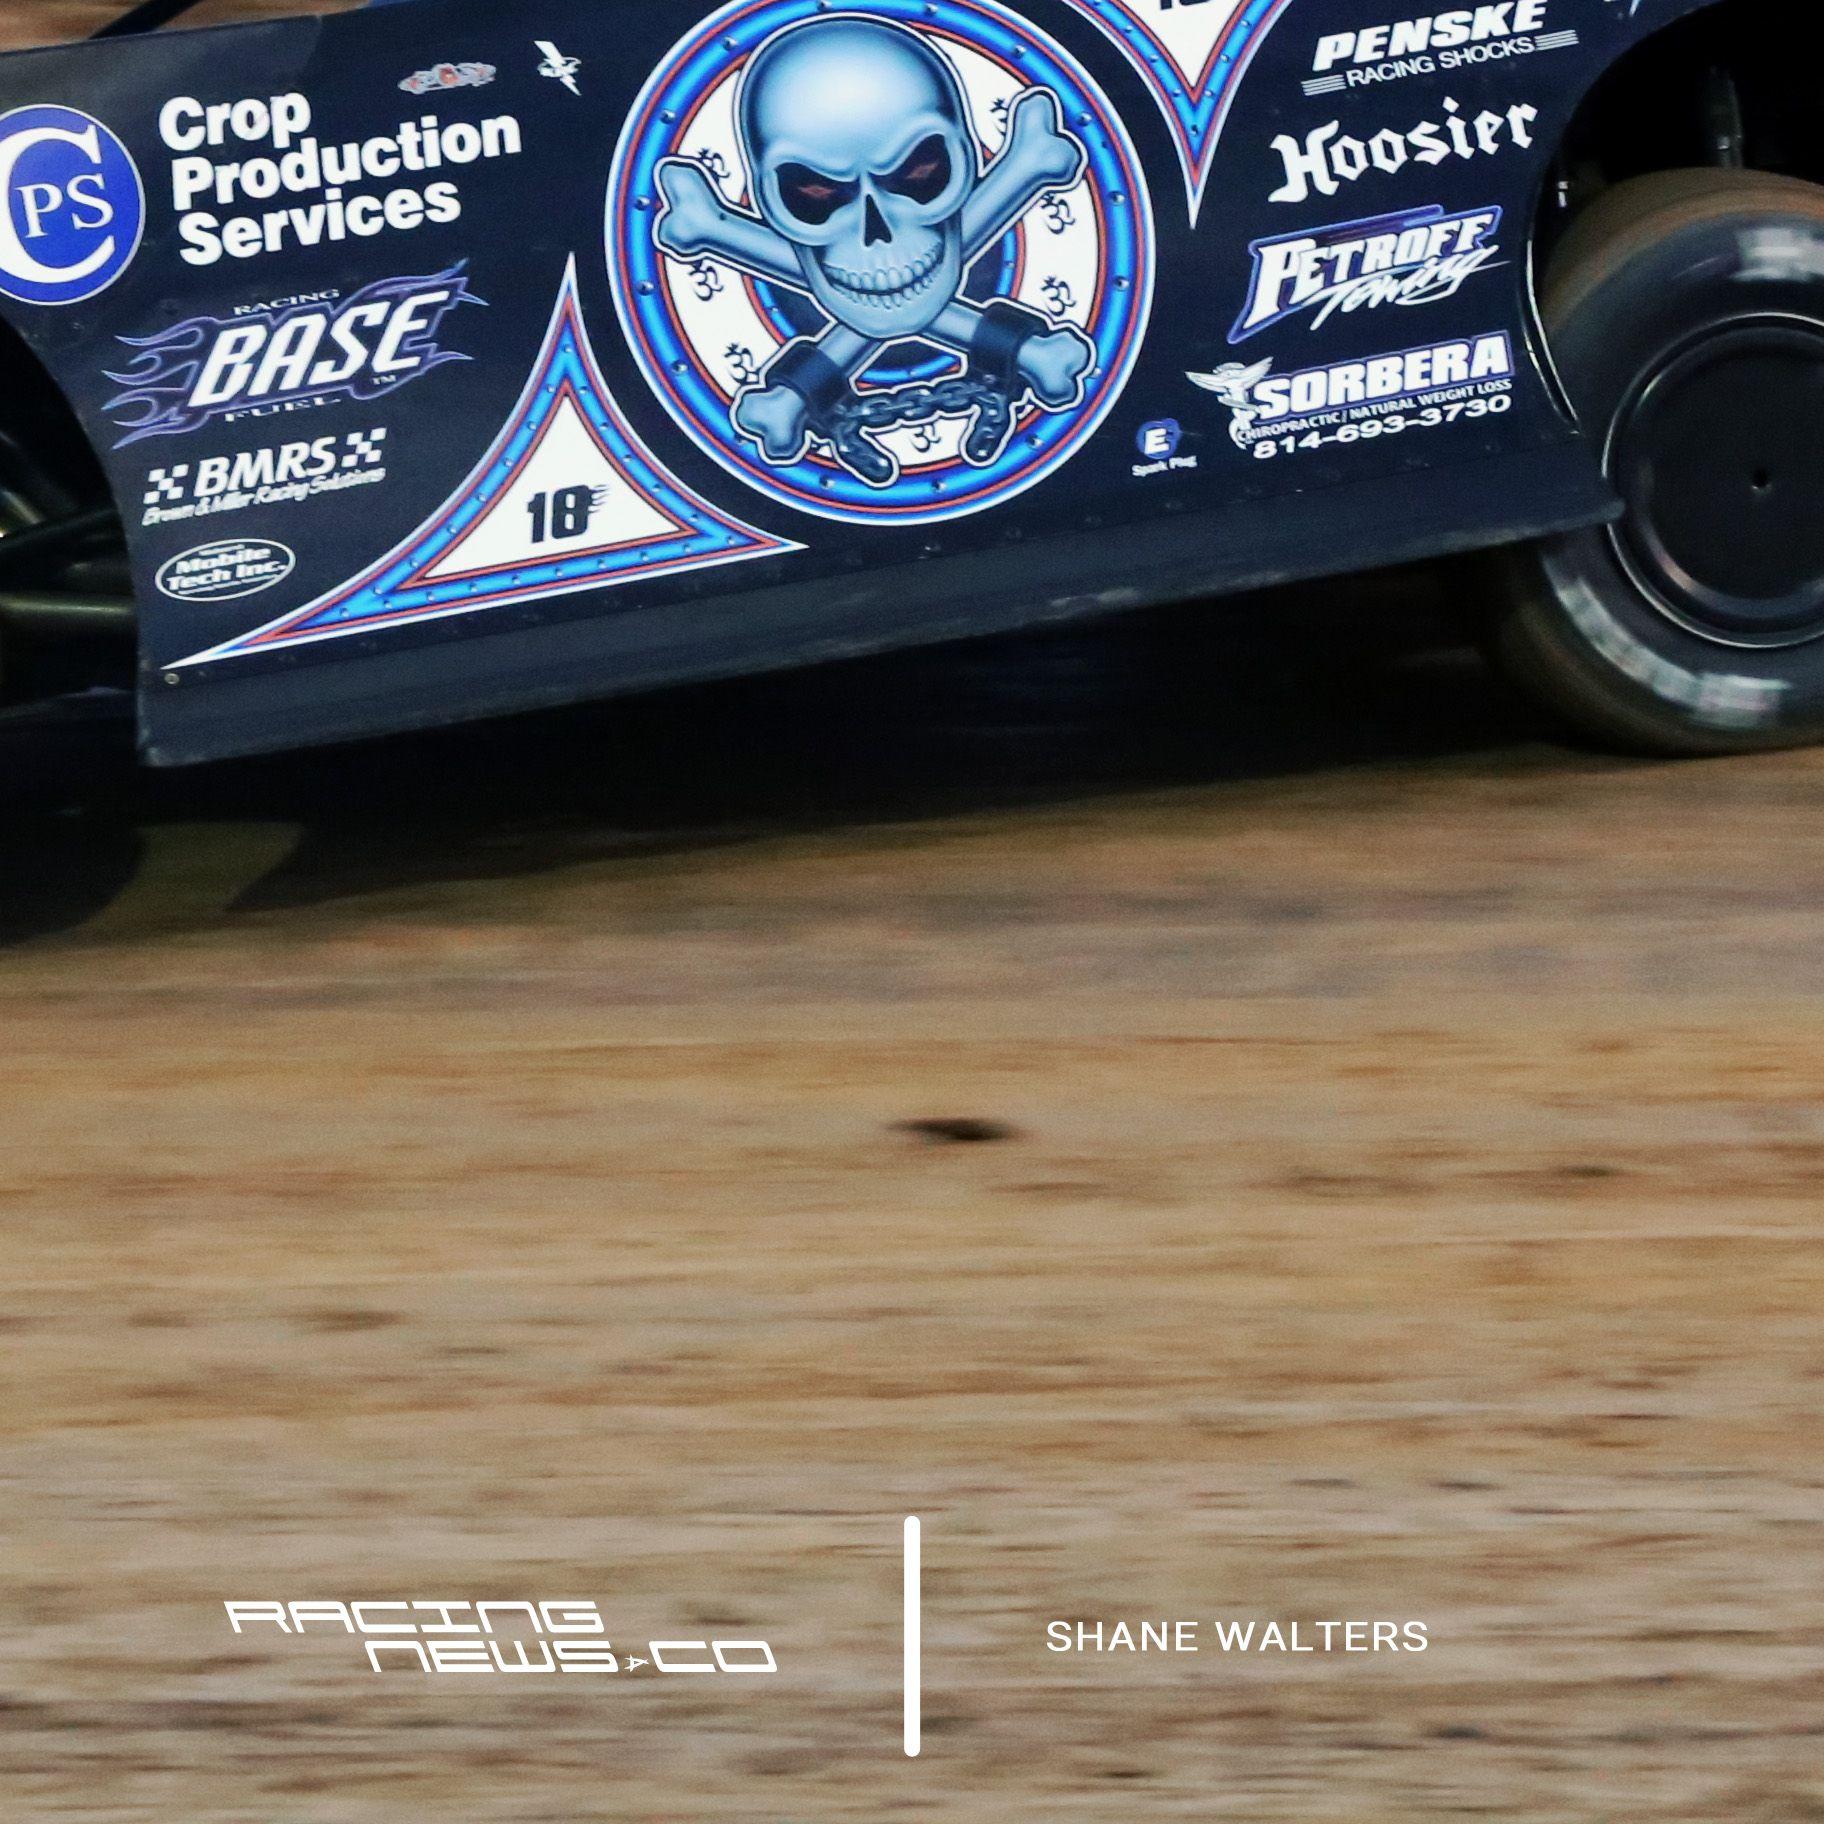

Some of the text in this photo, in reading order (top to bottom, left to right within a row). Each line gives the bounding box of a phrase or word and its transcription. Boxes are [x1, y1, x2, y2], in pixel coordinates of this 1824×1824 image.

[1346, 36, 1536, 87] RACING SHOCKS
[159, 92, 312, 151] Crop
[1268, 95, 1538, 204] Hoosier
[171, 114, 523, 211] Production
[177, 181, 462, 266] Services
[1242, 213, 1494, 329] PETROFF
[233, 289, 341, 316] RACING
[187, 290, 449, 408] BASE
[1254, 336, 1510, 419] SORBERA
[1418, 384, 1475, 407] WEIGHT
[1478, 378, 1513, 394] LOSS
[1253, 394, 1513, 460] 814-693-3730
[193, 436, 337, 497] BMRS
[526, 484, 608, 544] 18
[166, 568, 232, 591] Tech
[176, 547, 272, 574] Mobile
